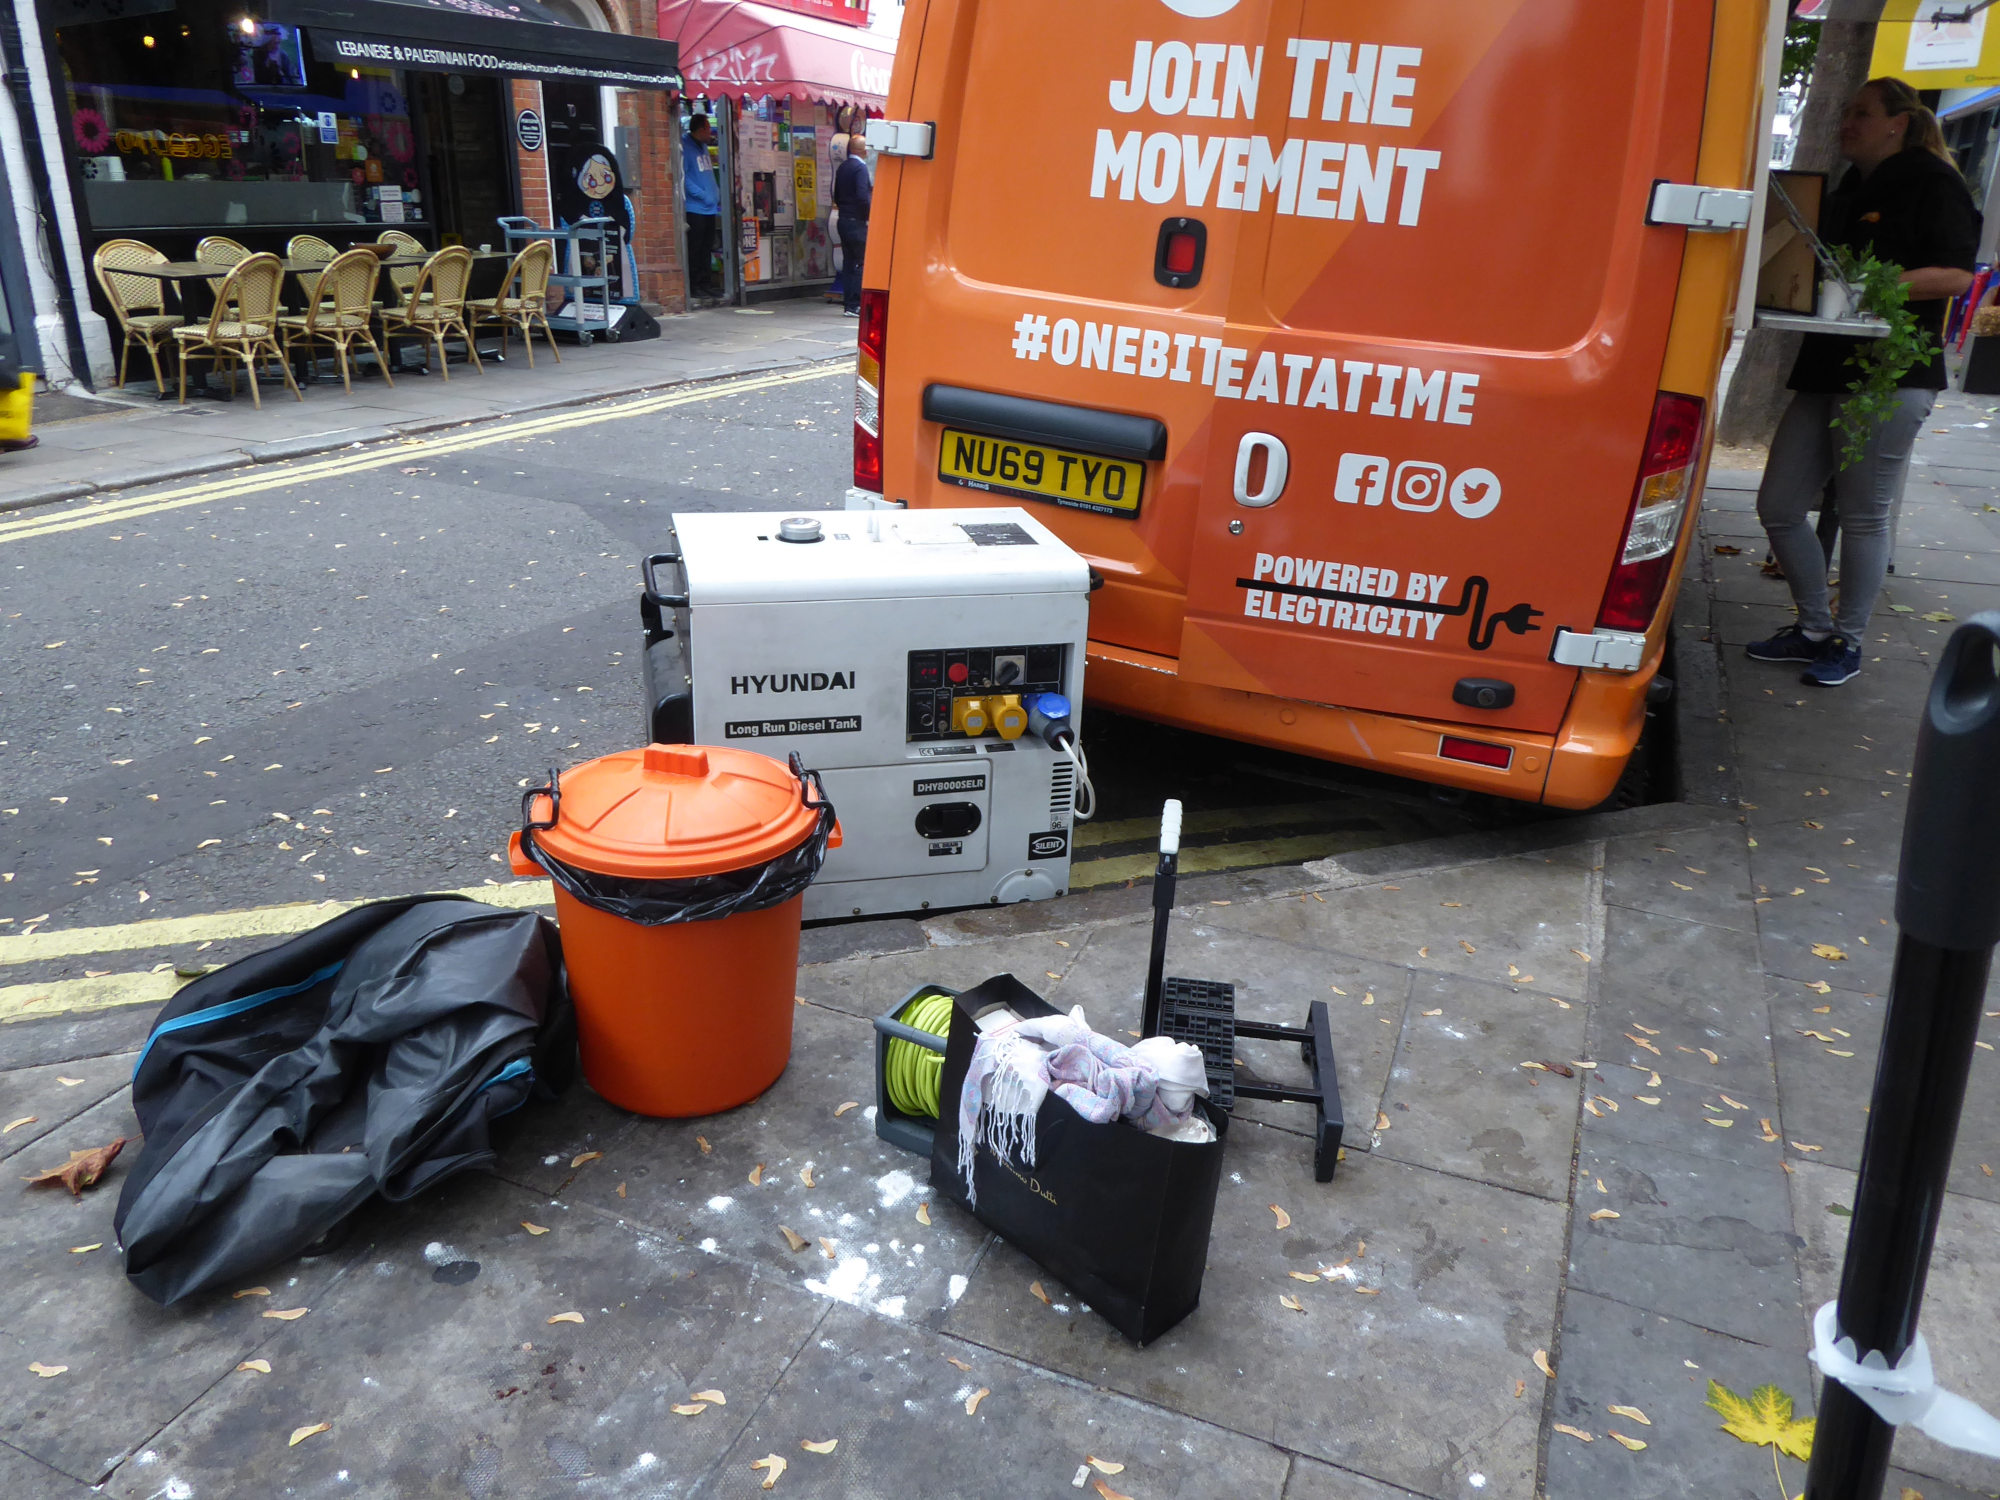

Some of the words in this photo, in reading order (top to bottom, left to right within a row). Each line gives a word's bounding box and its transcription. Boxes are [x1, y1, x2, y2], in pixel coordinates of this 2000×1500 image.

[336, 41, 393, 60] LEBANESE
[394, 46, 405, 61] &
[404, 47, 468, 66] PALESTINIAN
[468, 54, 499, 69] FOOD
[1108, 40, 1264, 120] JOIN
[1286, 38, 1423, 127] THE
[1090, 129, 1442, 226] MOVEMENT
[1011, 313, 1480, 425] #ONEBITEATATIME
[954, 436, 1045, 485] NU69
[1253, 552, 1399, 598] POWERED
[1405, 572, 1448, 603] BY
[1244, 588, 1445, 640] ELECTRICITY
[731, 671, 855, 694] HYUNDAI
[729, 724, 759, 736] Long
[762, 722, 785, 733] Run
[789, 720, 826, 732] Diesel
[829, 718, 858, 729] Tank
[917, 780, 984, 792] DHY8000SELR
[1035, 841, 1061, 850] SILENT
